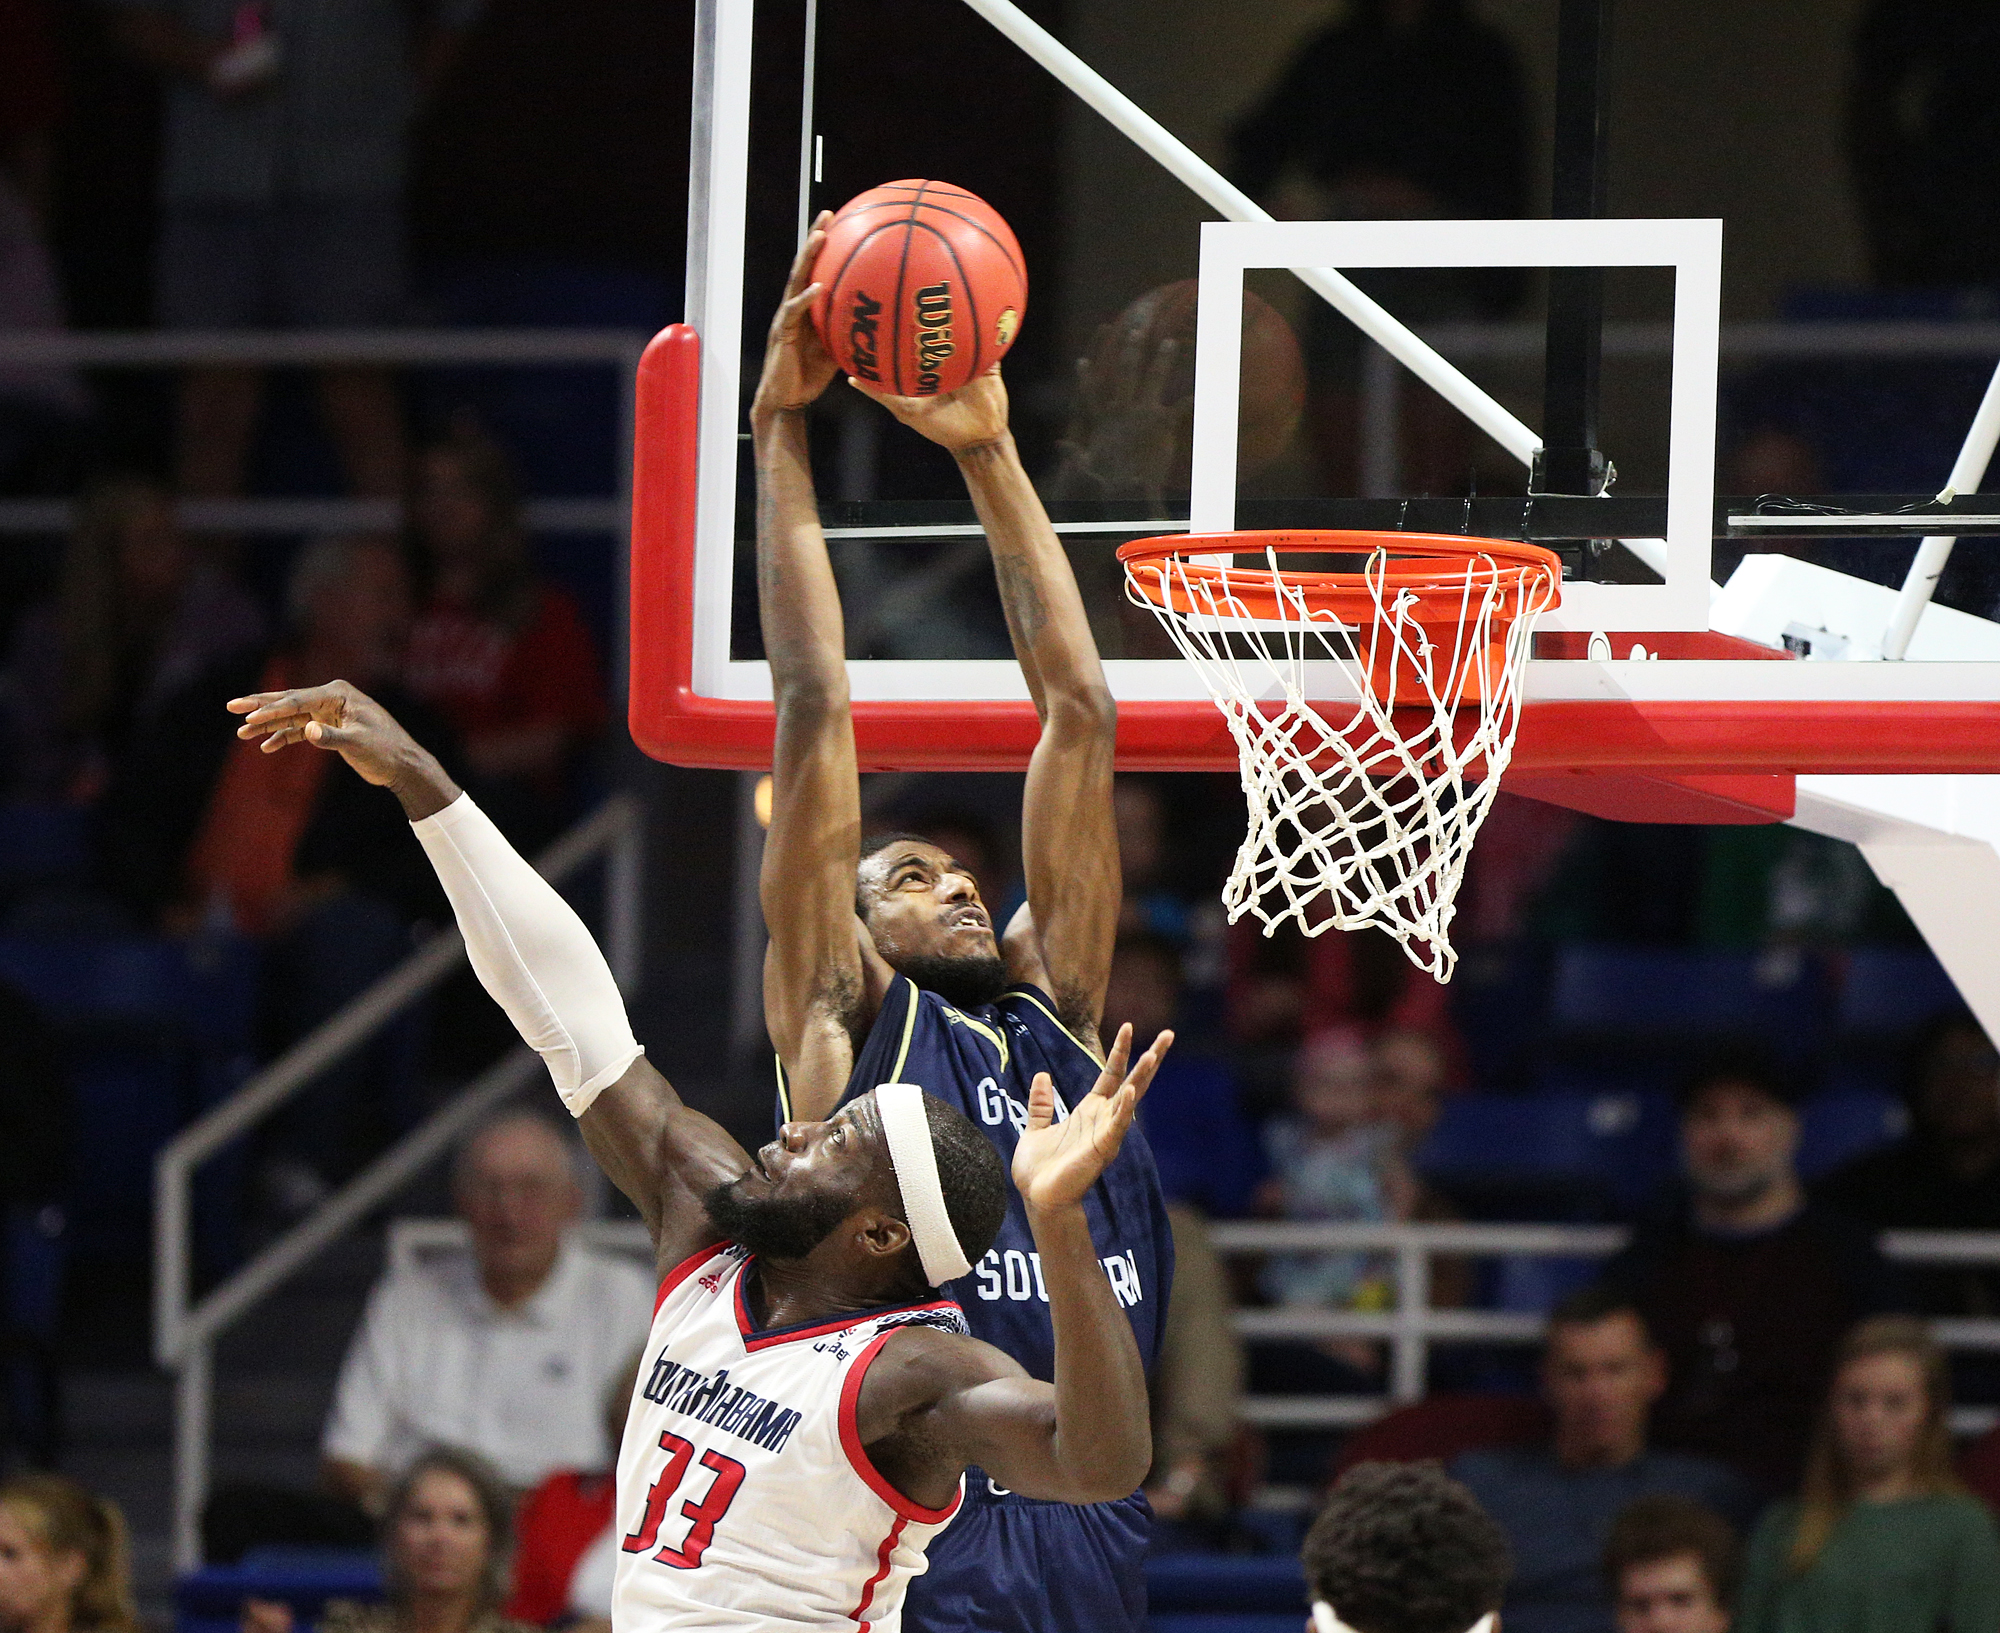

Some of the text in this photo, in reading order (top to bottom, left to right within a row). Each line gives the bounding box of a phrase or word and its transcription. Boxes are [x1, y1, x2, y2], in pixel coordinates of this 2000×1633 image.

[852, 291, 882, 382] NCAA
[914, 280, 955, 394] Wilson
[622, 1430, 746, 1570] 33
